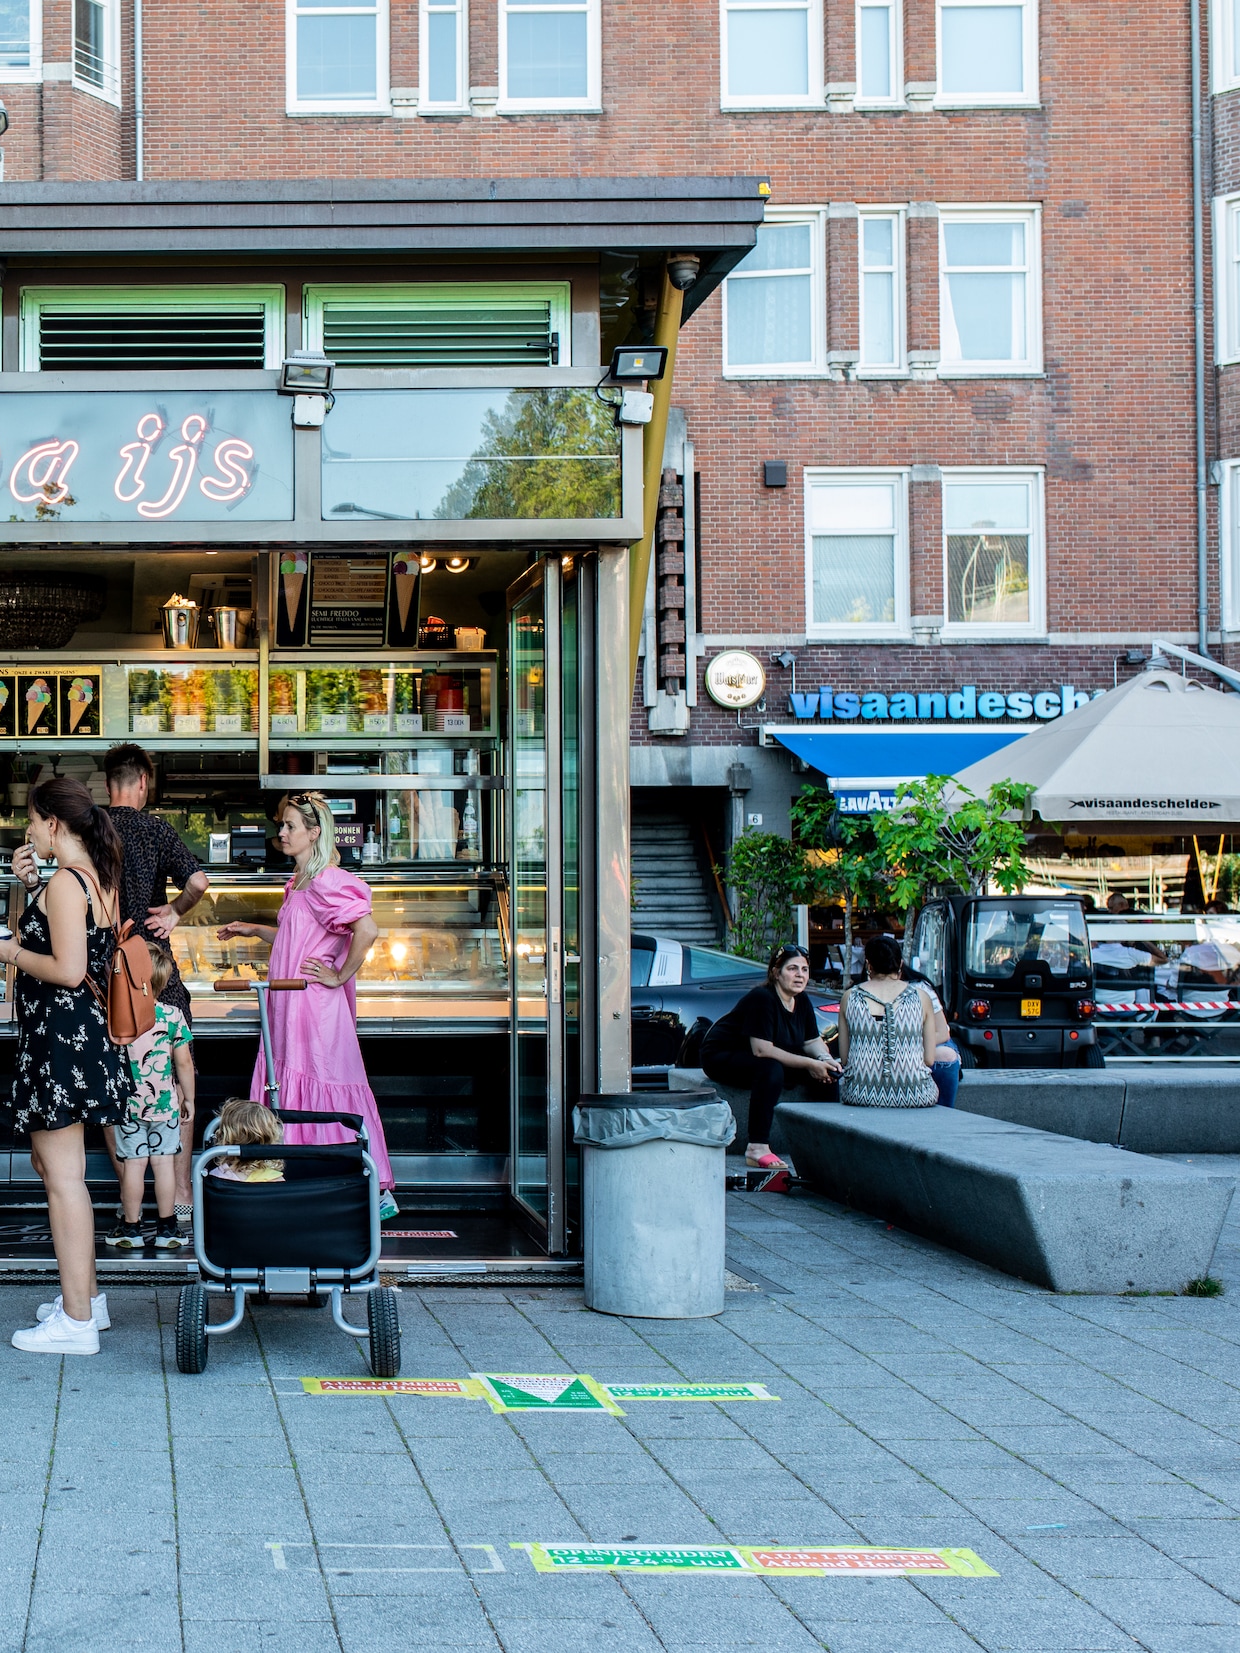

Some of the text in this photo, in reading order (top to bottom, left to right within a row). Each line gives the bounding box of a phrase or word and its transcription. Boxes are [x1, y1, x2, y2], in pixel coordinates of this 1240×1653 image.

[114, 413, 255, 518] ijs
[790, 686, 1106, 718] visaandesch
[1085, 799, 1210, 808] visaandeschelde
[752, 814, 758, 824] 6
[554, 1550, 727, 1558] OPENINGTIJDEN
[766, 1560, 948, 1568] Afstand Houden
